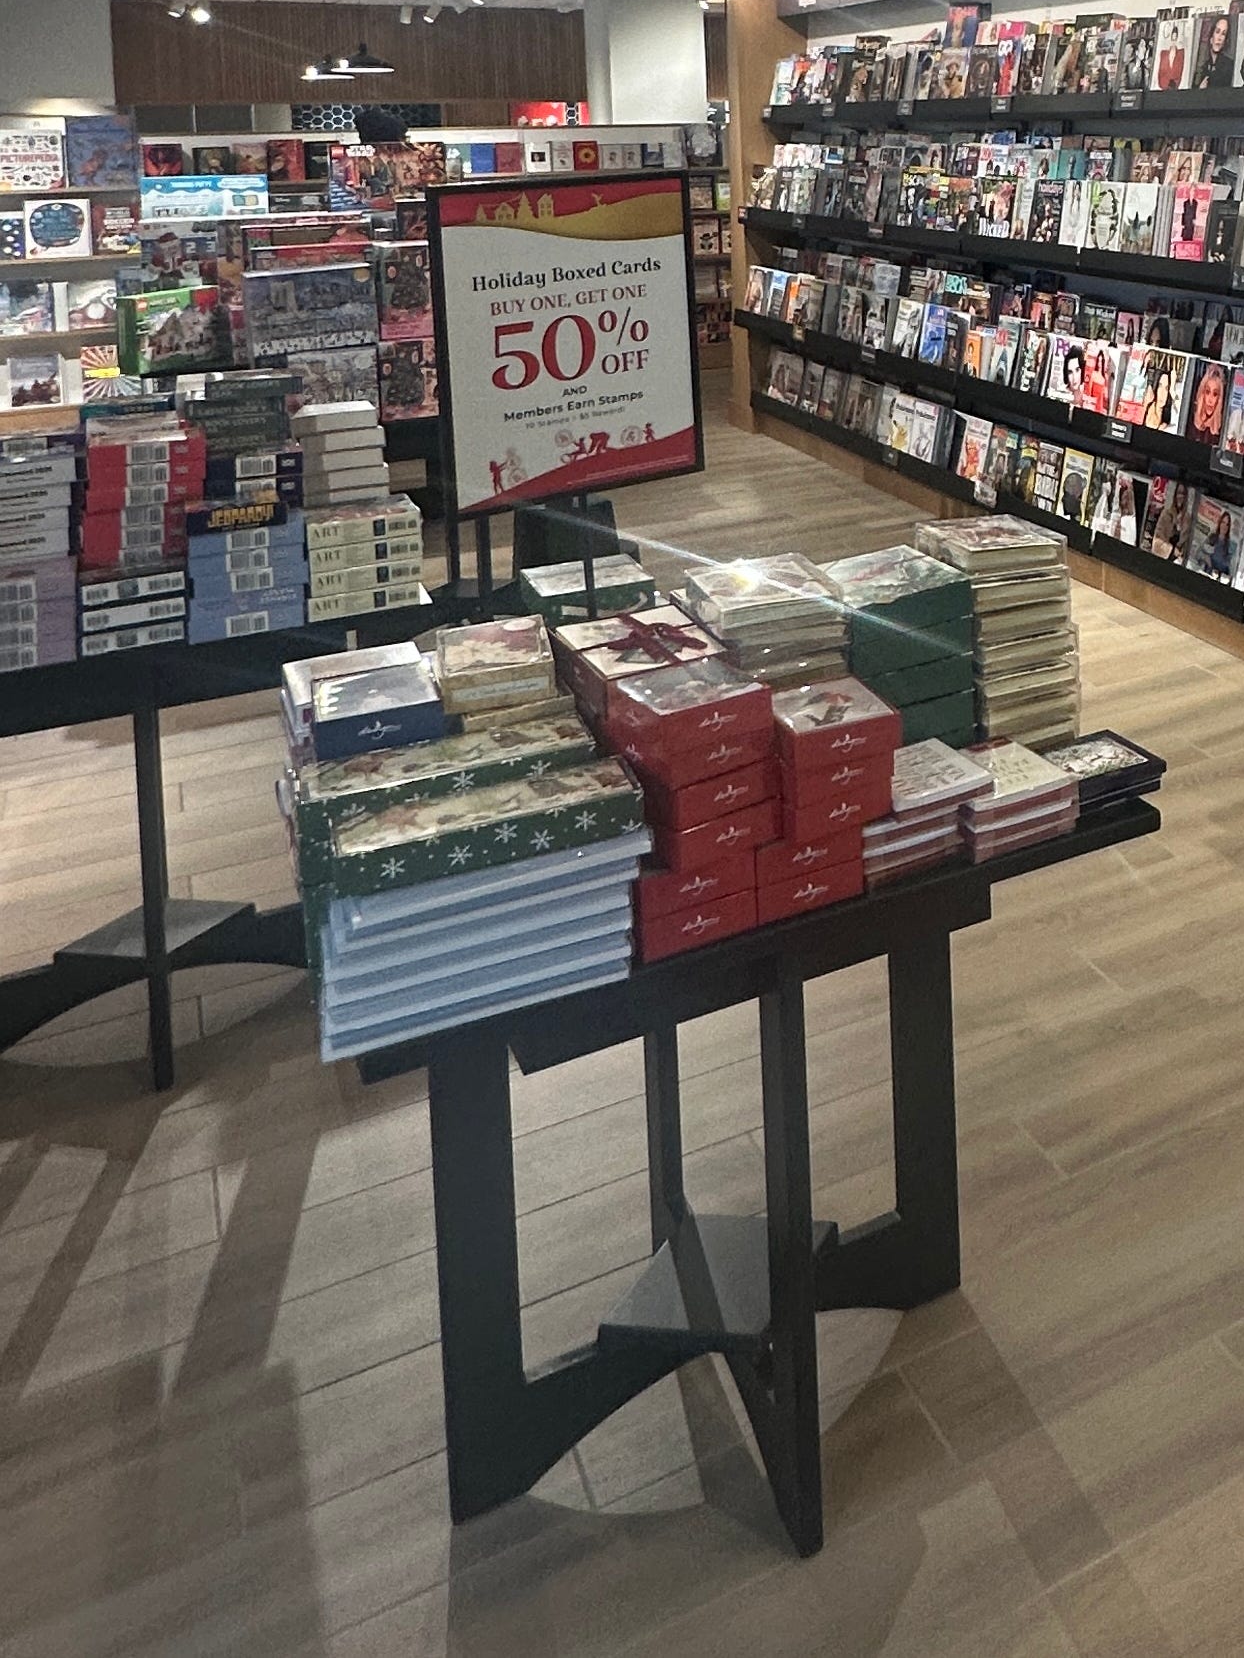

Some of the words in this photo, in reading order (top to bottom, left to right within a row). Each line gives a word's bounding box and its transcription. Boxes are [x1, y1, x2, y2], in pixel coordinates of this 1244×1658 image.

[472, 271, 546, 292] Holiday
[551, 262, 606, 283] Boxed
[611, 257, 662, 275] Cards
[490, 298, 525, 317] BUY
[530, 294, 572, 311] ONE,
[576, 288, 609, 306] GET
[612, 283, 648, 300] ONE
[491, 306, 650, 390] 50%
[601, 349, 649, 375] OFF
[562, 385, 588, 398] AND
[503, 403, 564, 423] Members
[567, 397, 596, 411] Earn
[599, 390, 644, 407] Stamps
[207, 505, 275, 528] JEOPARDY!
[313, 525, 340, 540] ART
[314, 550, 342, 563] ART
[316, 574, 343, 588] ART
[313, 598, 341, 612] ART
